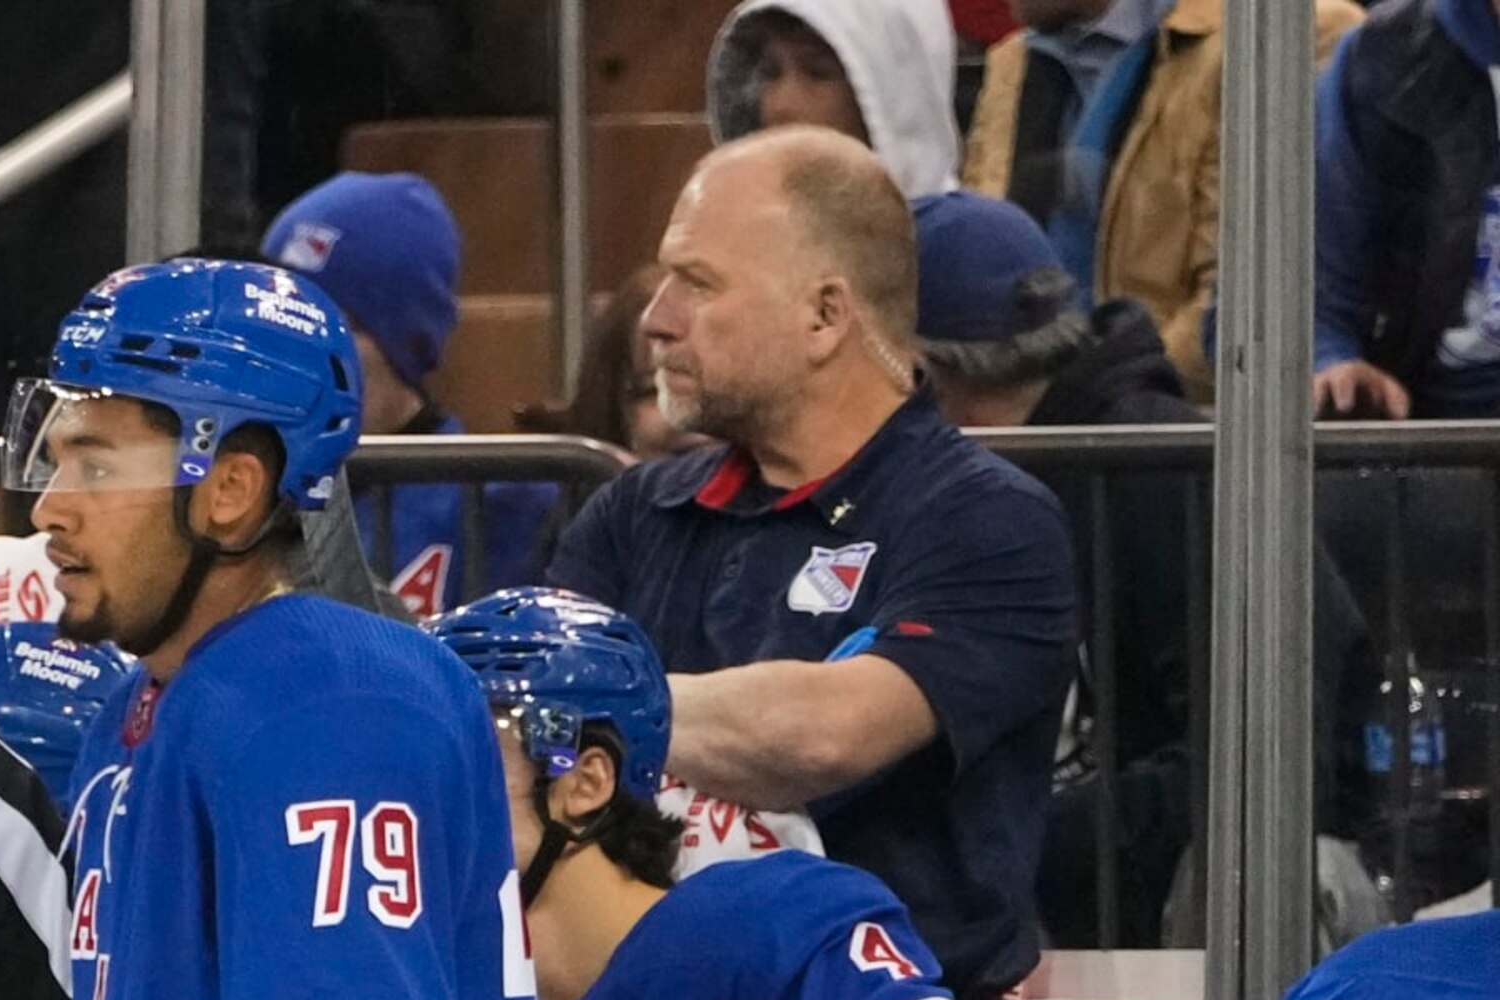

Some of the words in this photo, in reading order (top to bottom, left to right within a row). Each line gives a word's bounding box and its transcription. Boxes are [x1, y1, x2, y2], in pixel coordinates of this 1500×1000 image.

[244, 283, 326, 323] Benjamin
[257, 303, 316, 336] Moore
[61, 325, 105, 343] CCM
[14, 641, 101, 680] Benjamin
[19, 659, 84, 691] Moore
[284, 799, 423, 929] 79
